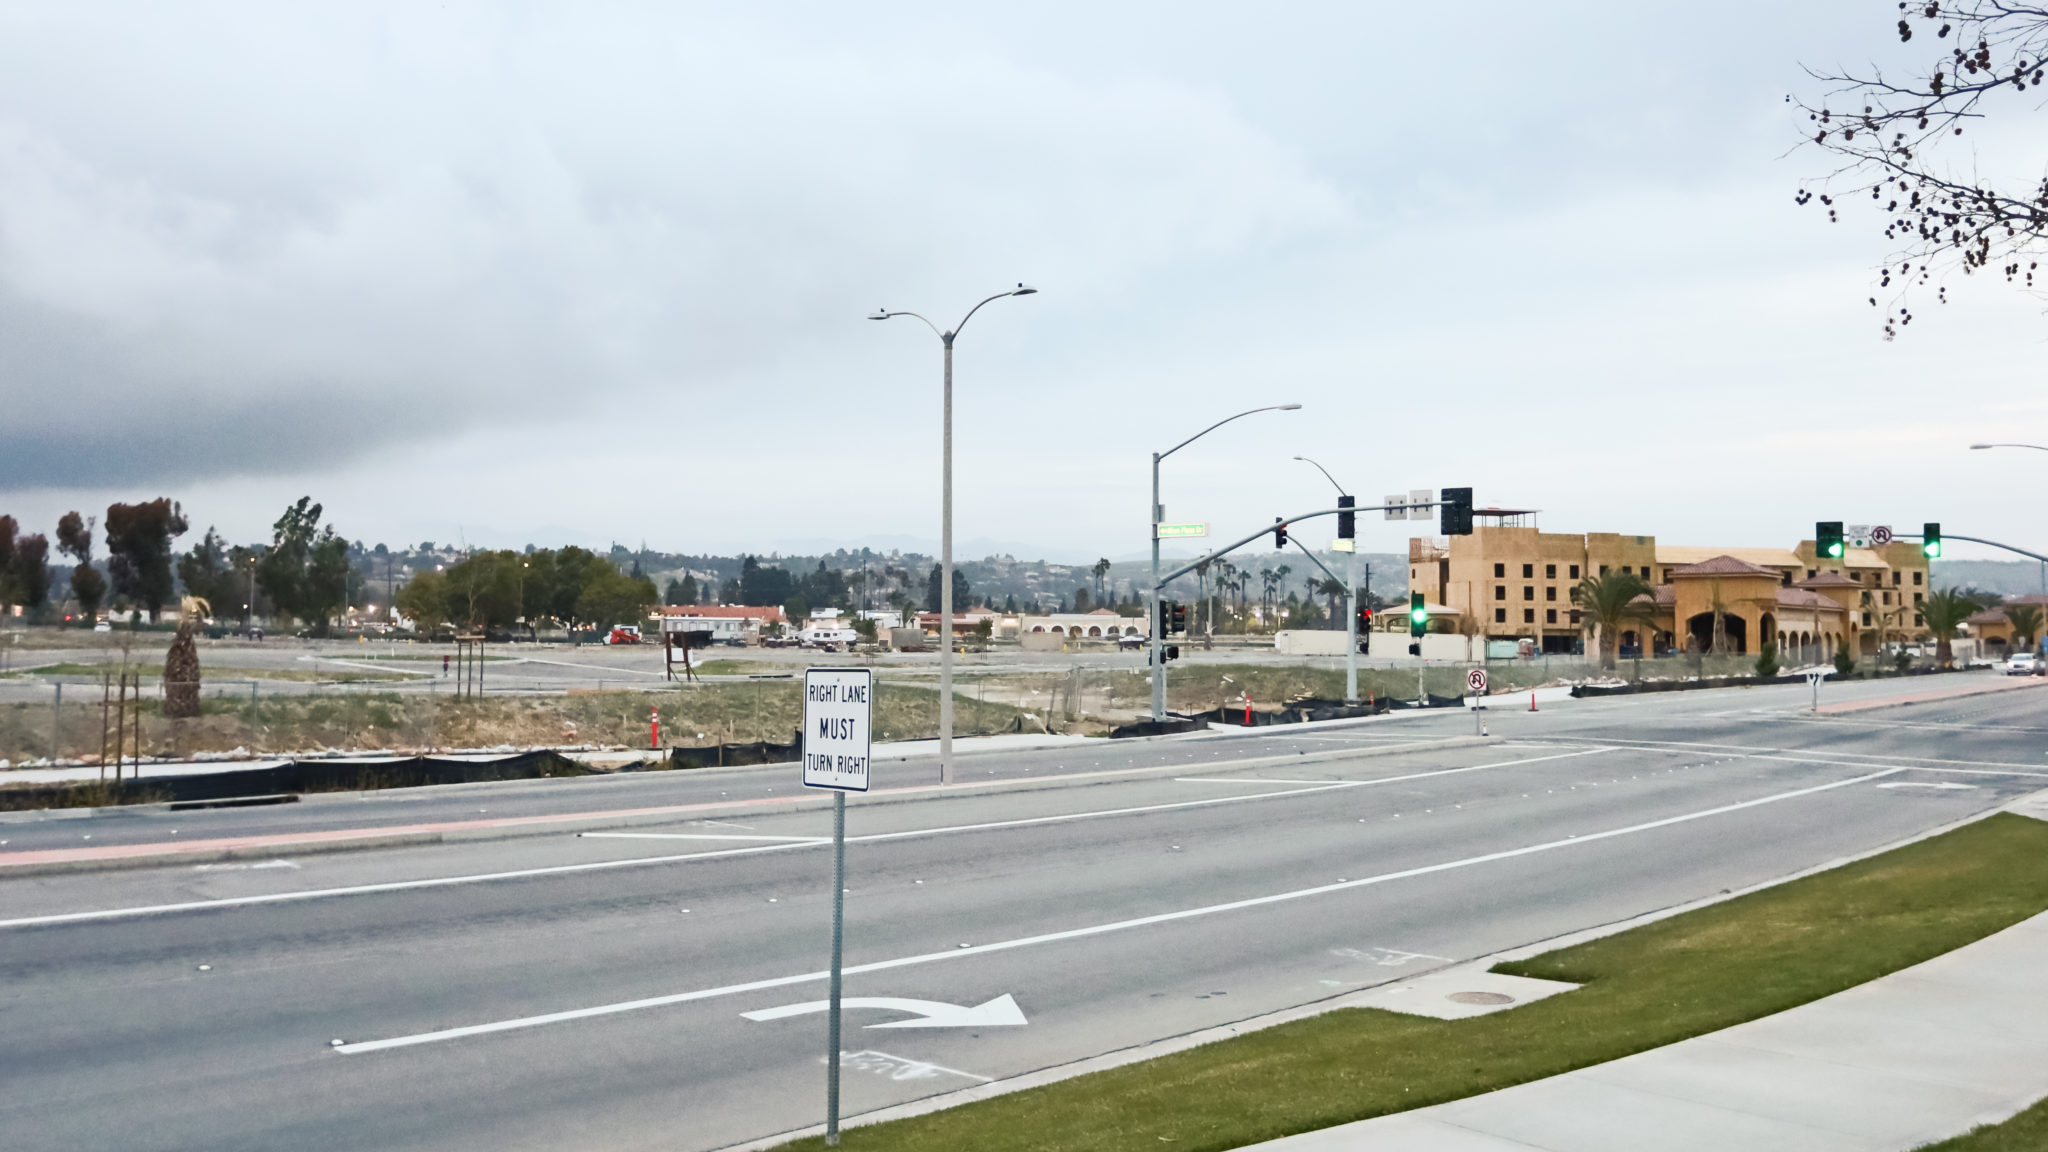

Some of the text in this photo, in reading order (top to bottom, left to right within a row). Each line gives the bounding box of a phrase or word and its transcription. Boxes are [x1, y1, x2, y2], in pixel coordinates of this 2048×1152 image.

[809, 685, 867, 703] RIGHT LANE
[819, 717, 855, 740] MUST
[807, 753, 866, 775] TURN RIGHT
